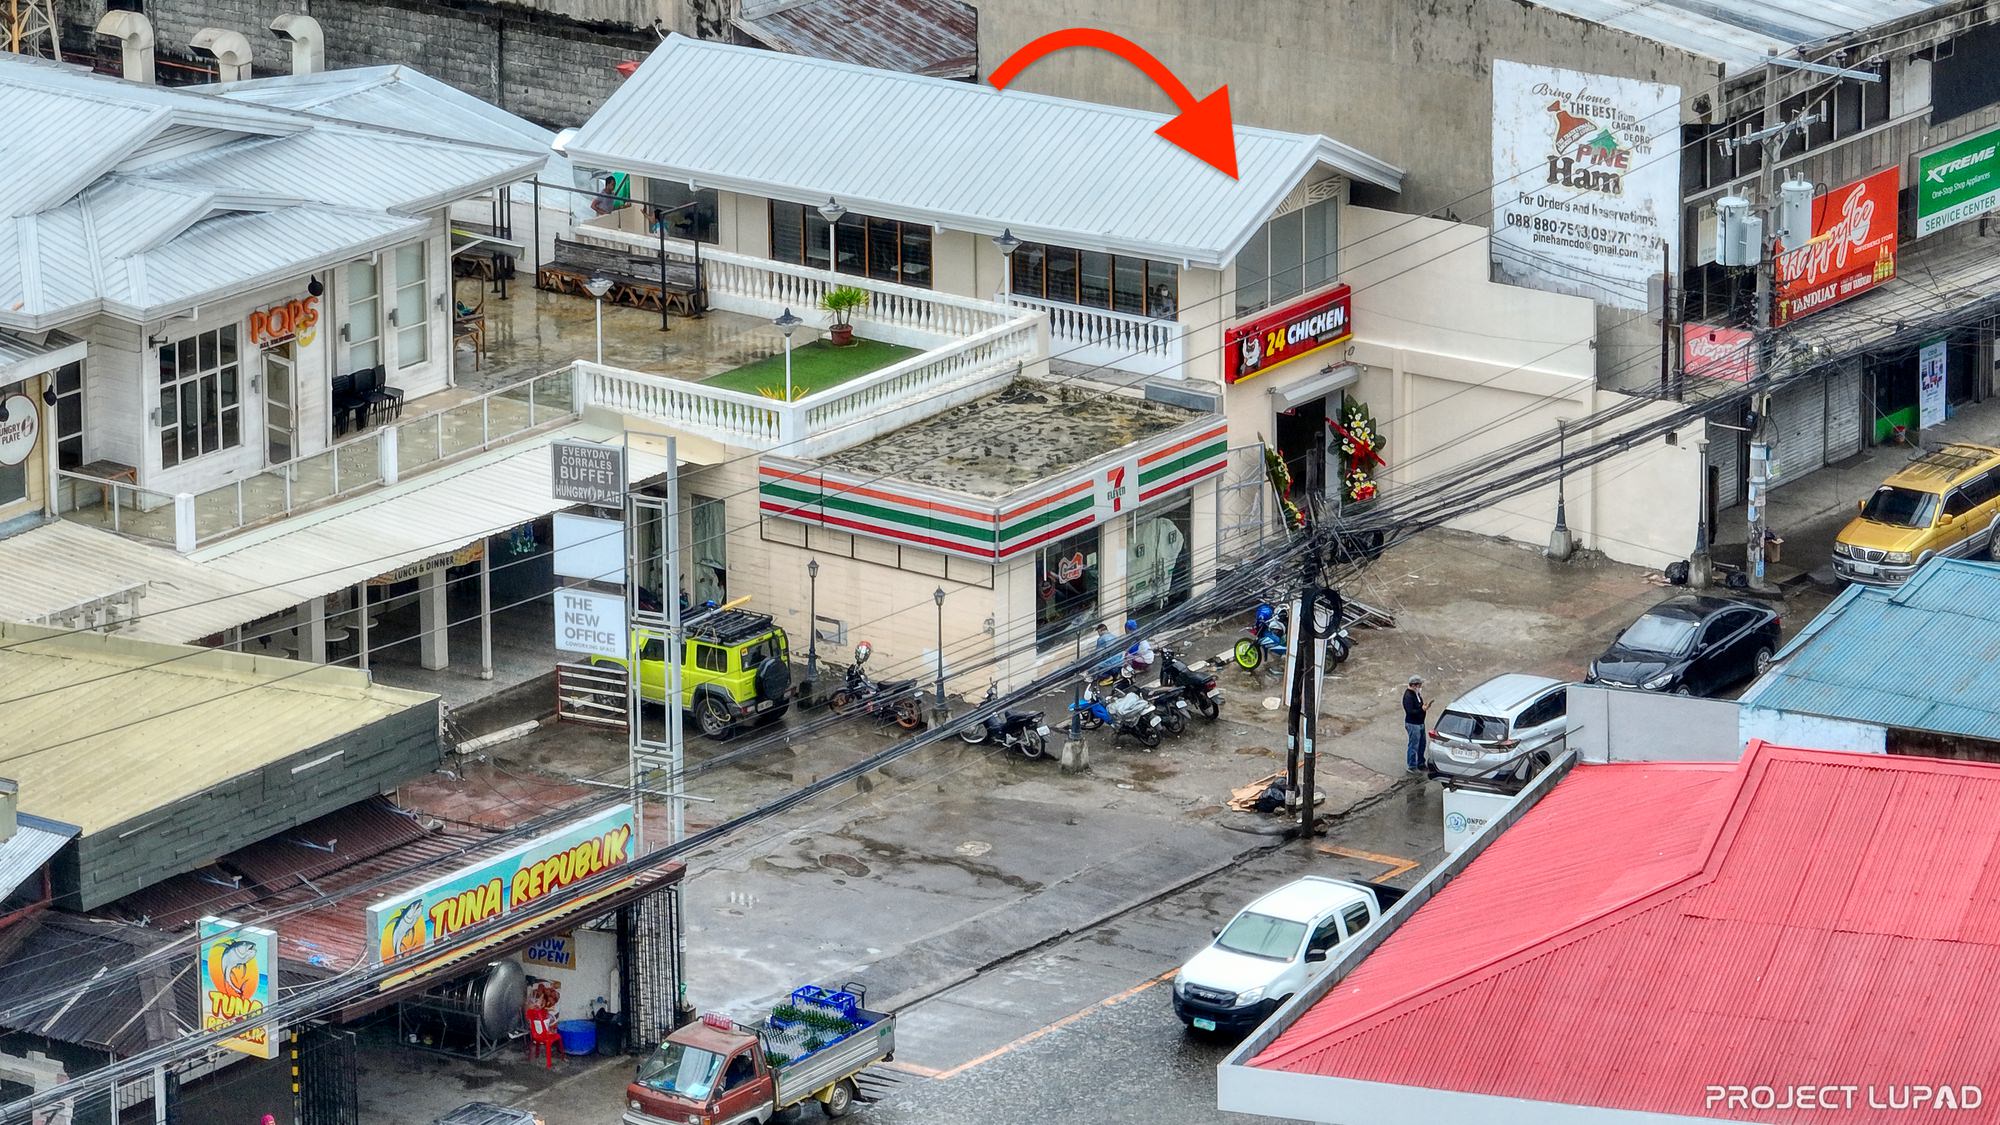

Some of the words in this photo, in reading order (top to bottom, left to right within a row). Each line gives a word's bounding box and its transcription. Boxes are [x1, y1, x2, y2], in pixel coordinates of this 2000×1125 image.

[1532, 83, 1572, 103] Bring
[1576, 87, 1611, 105] home
[1570, 102, 1590, 116] THE
[1592, 105, 1616, 119] BEST
[1576, 144, 1631, 169] PINE
[1635, 145, 1652, 155] CITY
[1547, 155, 1621, 194] Ham
[1926, 146, 1996, 183] XTREME
[1519, 192, 1534, 206] For
[1537, 195, 1570, 212] Orders
[1573, 204, 1589, 215] and
[1925, 208, 1961, 231] SERVICE
[1963, 195, 1996, 216] CENTER
[1791, 283, 1838, 314] TANDUAY
[249, 296, 319, 345] POPS
[1266, 328, 1286, 357] 24
[1287, 306, 1345, 345] CHICKEN
[0, 423, 21, 437] UNGRY
[2, 432, 21, 445] PLATE
[561, 456, 612, 470] CORRALES
[562, 446, 610, 460] EVERYDAY
[560, 466, 614, 485] BUFFET
[555, 484, 588, 499] HUNGRY
[597, 489, 620, 504] PLATE
[394, 566, 418, 582] LUNCH
[419, 564, 425, 573] &
[426, 555, 454, 571] DINNER
[564, 596, 592, 611] THE
[564, 612, 600, 627] NEW
[564, 627, 616, 646] OFFICE
[429, 877, 504, 943] TUNA
[511, 823, 631, 911] REPUBLIK
[528, 947, 570, 964] OPEN!
[208, 991, 264, 1020] TUNA
